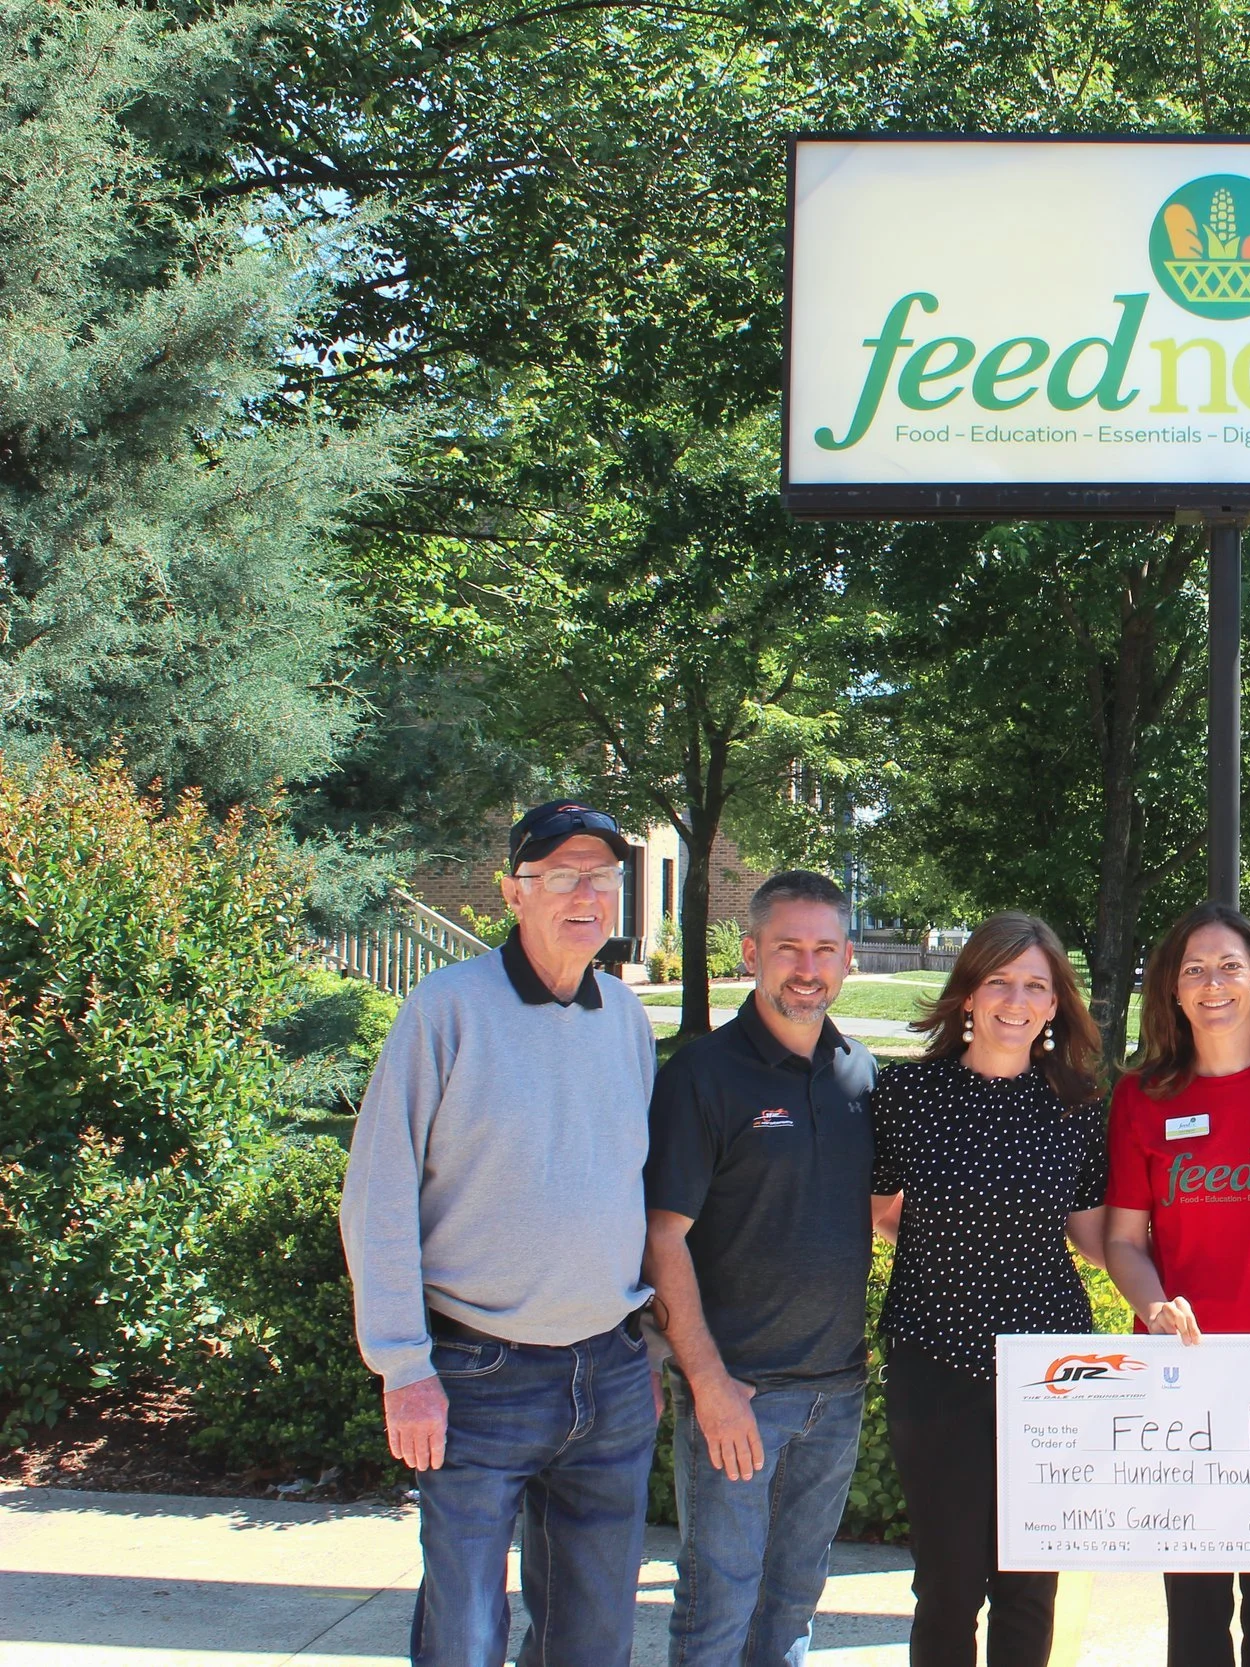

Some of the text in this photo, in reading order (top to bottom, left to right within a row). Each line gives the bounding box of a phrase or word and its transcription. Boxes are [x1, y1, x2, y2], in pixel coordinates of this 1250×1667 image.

[895, 424, 950, 443] Food
[970, 425, 1077, 443] Education
[1098, 425, 1202, 444] Essentials
[1180, 1195, 1199, 1204] Food
[1205, 1194, 1242, 1203] Education
[1023, 1424, 1079, 1436] Pay to the
[1112, 1410, 1212, 1451] Feed
[1031, 1438, 1077, 1449] Order of
[1035, 1460, 1095, 1484] Three
[1114, 1459, 1194, 1484] Hundred
[1024, 1522, 1057, 1531] Memo
[1126, 1506, 1196, 1531] Garden
